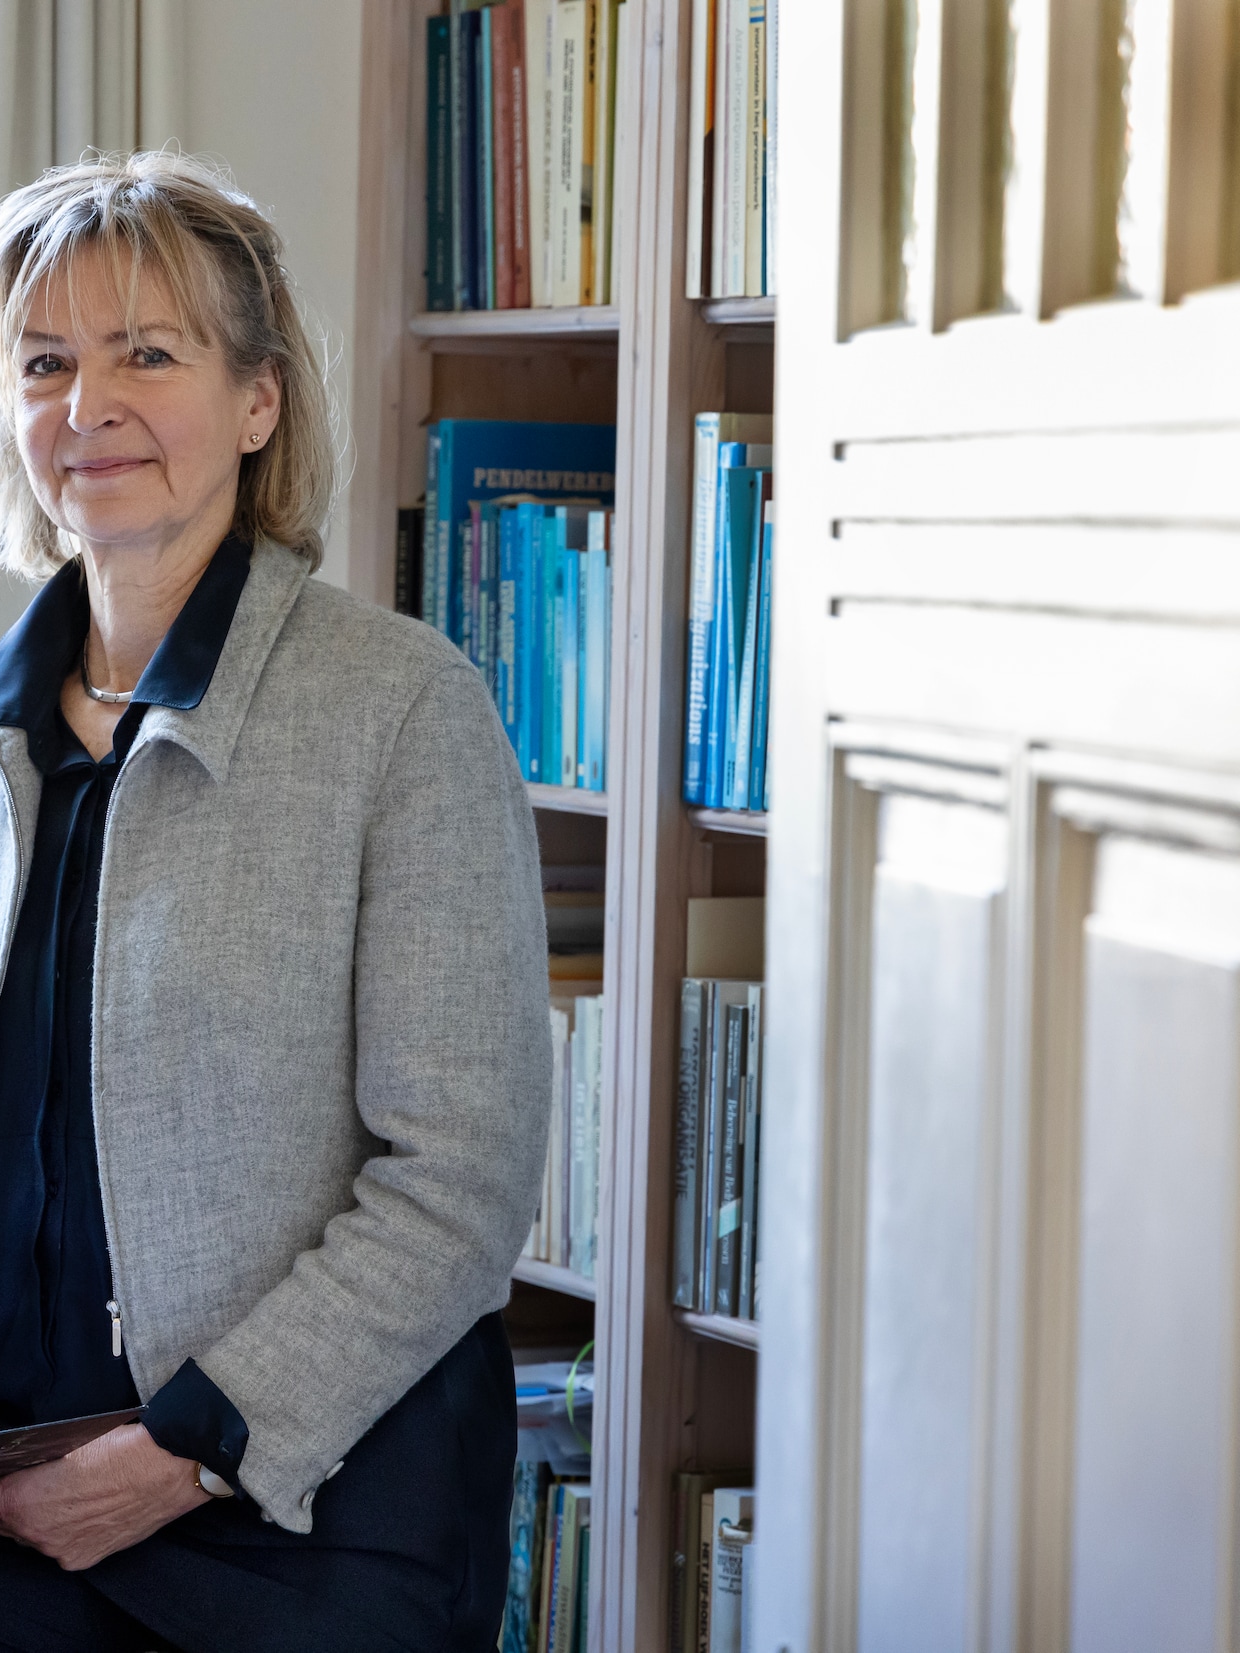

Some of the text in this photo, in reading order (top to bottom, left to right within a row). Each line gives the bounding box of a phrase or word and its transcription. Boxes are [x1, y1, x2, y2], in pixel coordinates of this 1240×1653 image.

[473, 466, 615, 492] PENDELWERKB
[687, 599, 712, 746] Organizations
[675, 1047, 693, 1200] EN ORGANISATIE
[724, 1099, 738, 1155] Beheersing
[724, 1156, 734, 1174] van
[701, 1542, 710, 1570] HET
